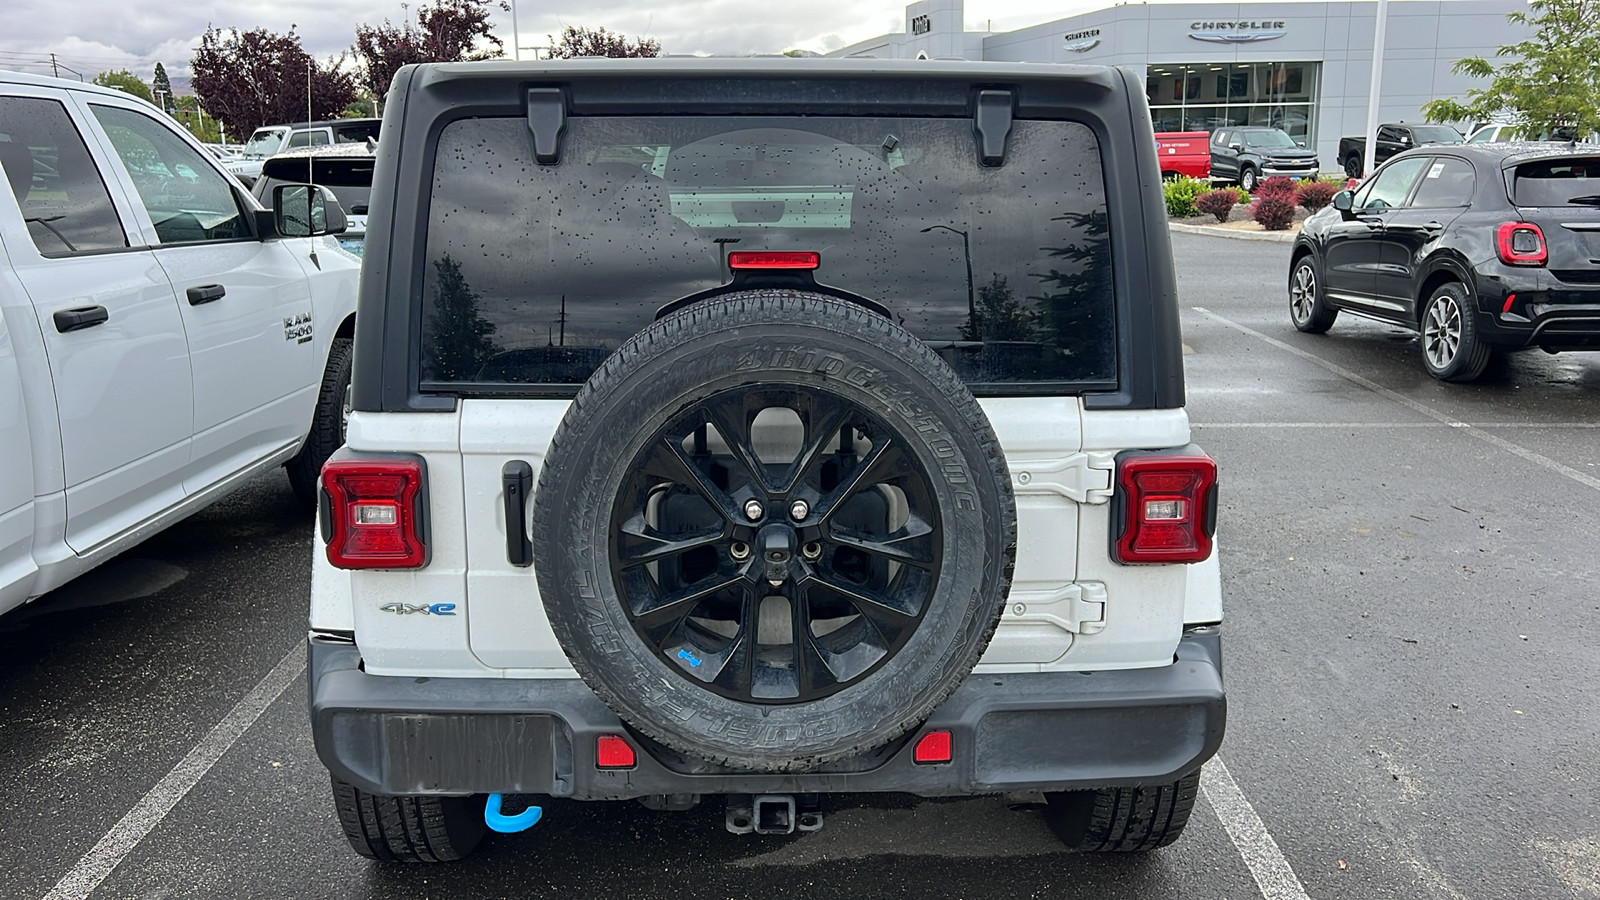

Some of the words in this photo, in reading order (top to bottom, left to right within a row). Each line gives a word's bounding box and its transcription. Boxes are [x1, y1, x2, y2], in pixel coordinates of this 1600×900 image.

[1190, 21, 1286, 30] CHRYSLER
[283, 312, 312, 329] RAM
[285, 324, 313, 341] 1500
[734, 346, 977, 512] BRIDGESTONE
[629, 671, 841, 744] DUELER
